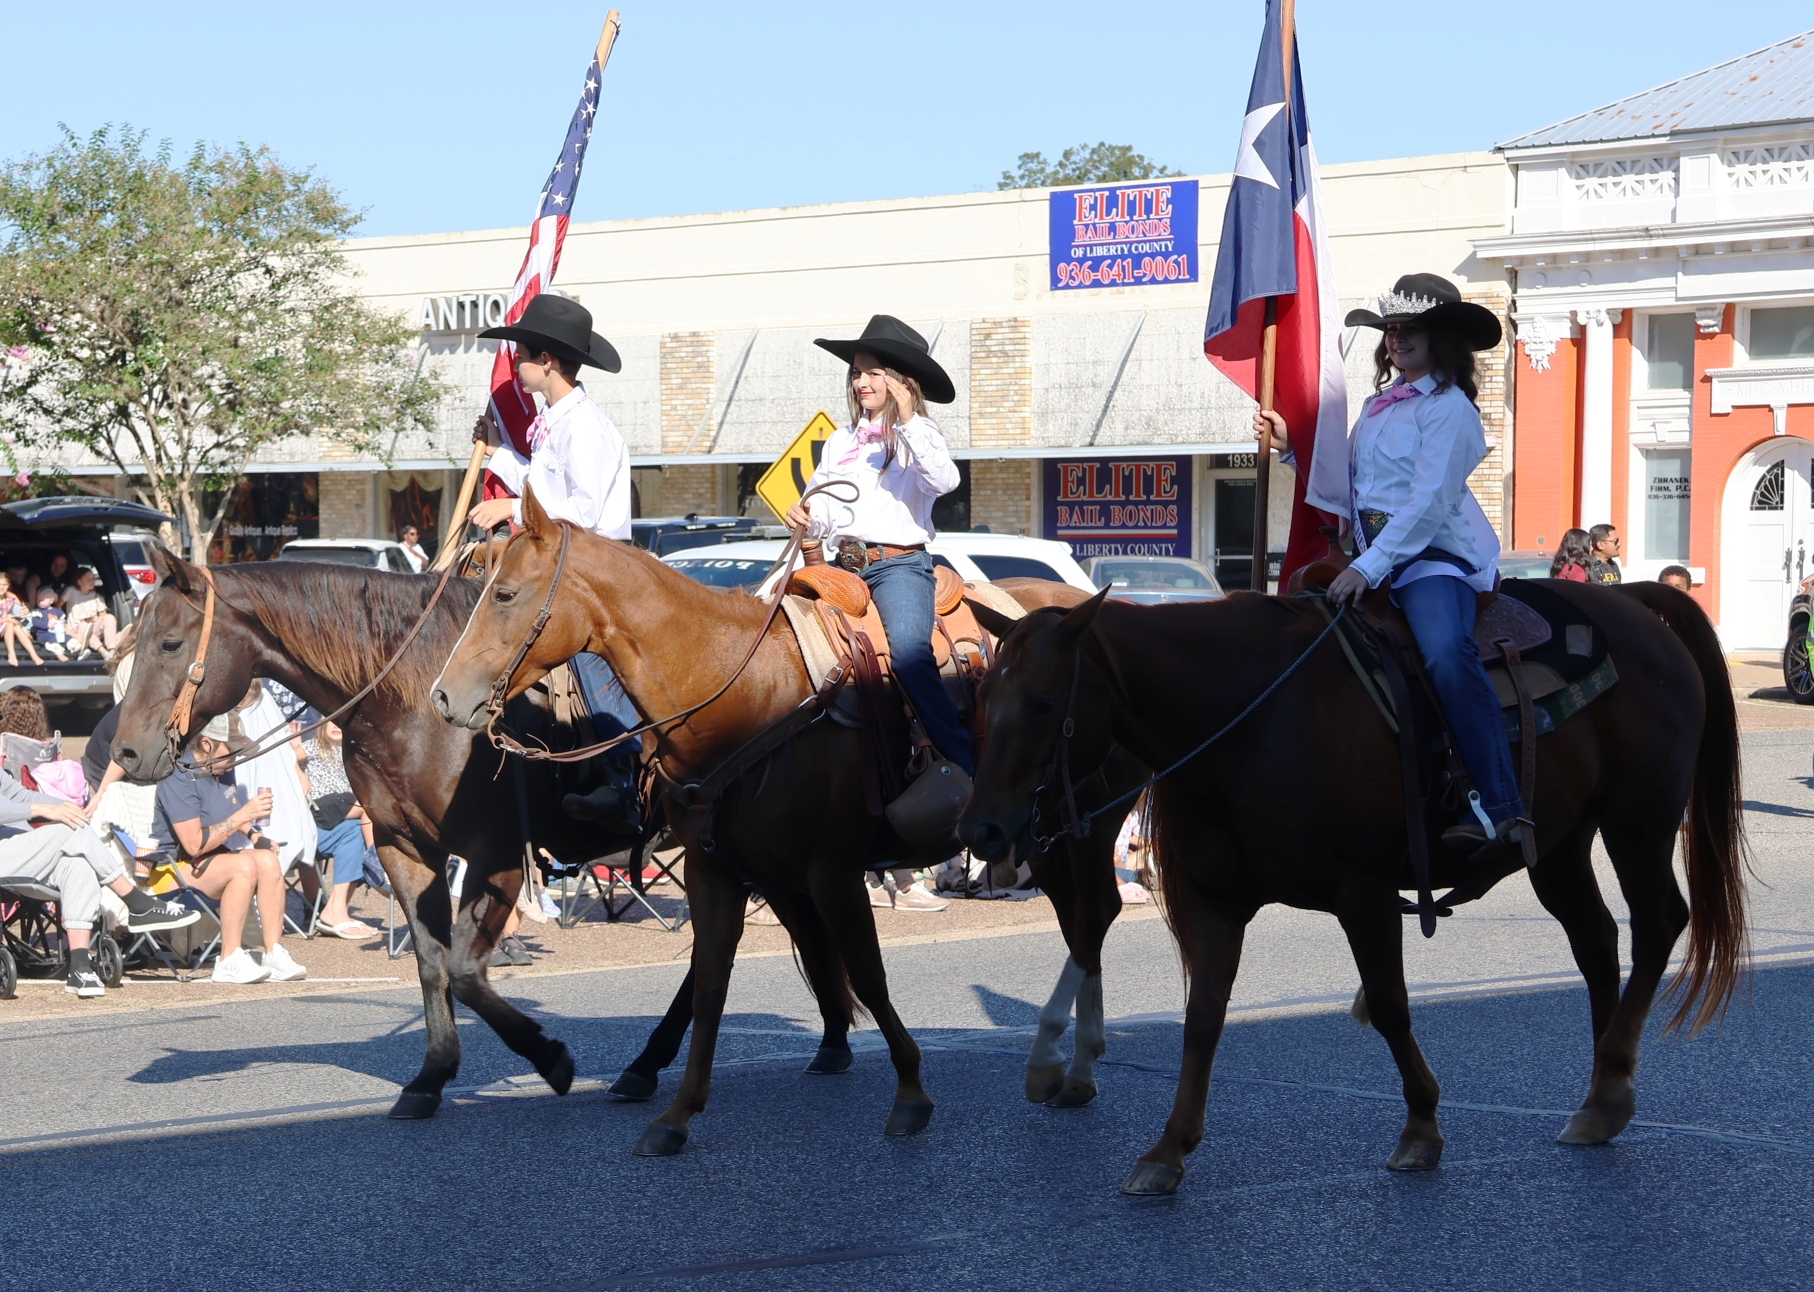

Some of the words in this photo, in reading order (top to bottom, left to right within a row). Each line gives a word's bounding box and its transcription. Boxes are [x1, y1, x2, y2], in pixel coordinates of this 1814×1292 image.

[1073, 186, 1172, 224] ELITE
[1074, 223, 1114, 242] BAIL
[1115, 218, 1171, 239] BONDS
[1071, 246, 1085, 258] OF
[1086, 243, 1132, 257] LIBERTY
[1131, 240, 1174, 254] COUNTY
[1057, 254, 1190, 287] 936-641-9061
[421, 292, 511, 330] ANTIQ
[1227, 453, 1255, 468] 1933
[1057, 461, 1178, 501] ELITE
[1650, 485, 1672, 493] FIRM,
[1057, 505, 1105, 527] BAIL
[1110, 504, 1178, 527] BONDS
[1076, 543, 1125, 556] LIBERTY
[1127, 543, 1176, 556] COUNTY
